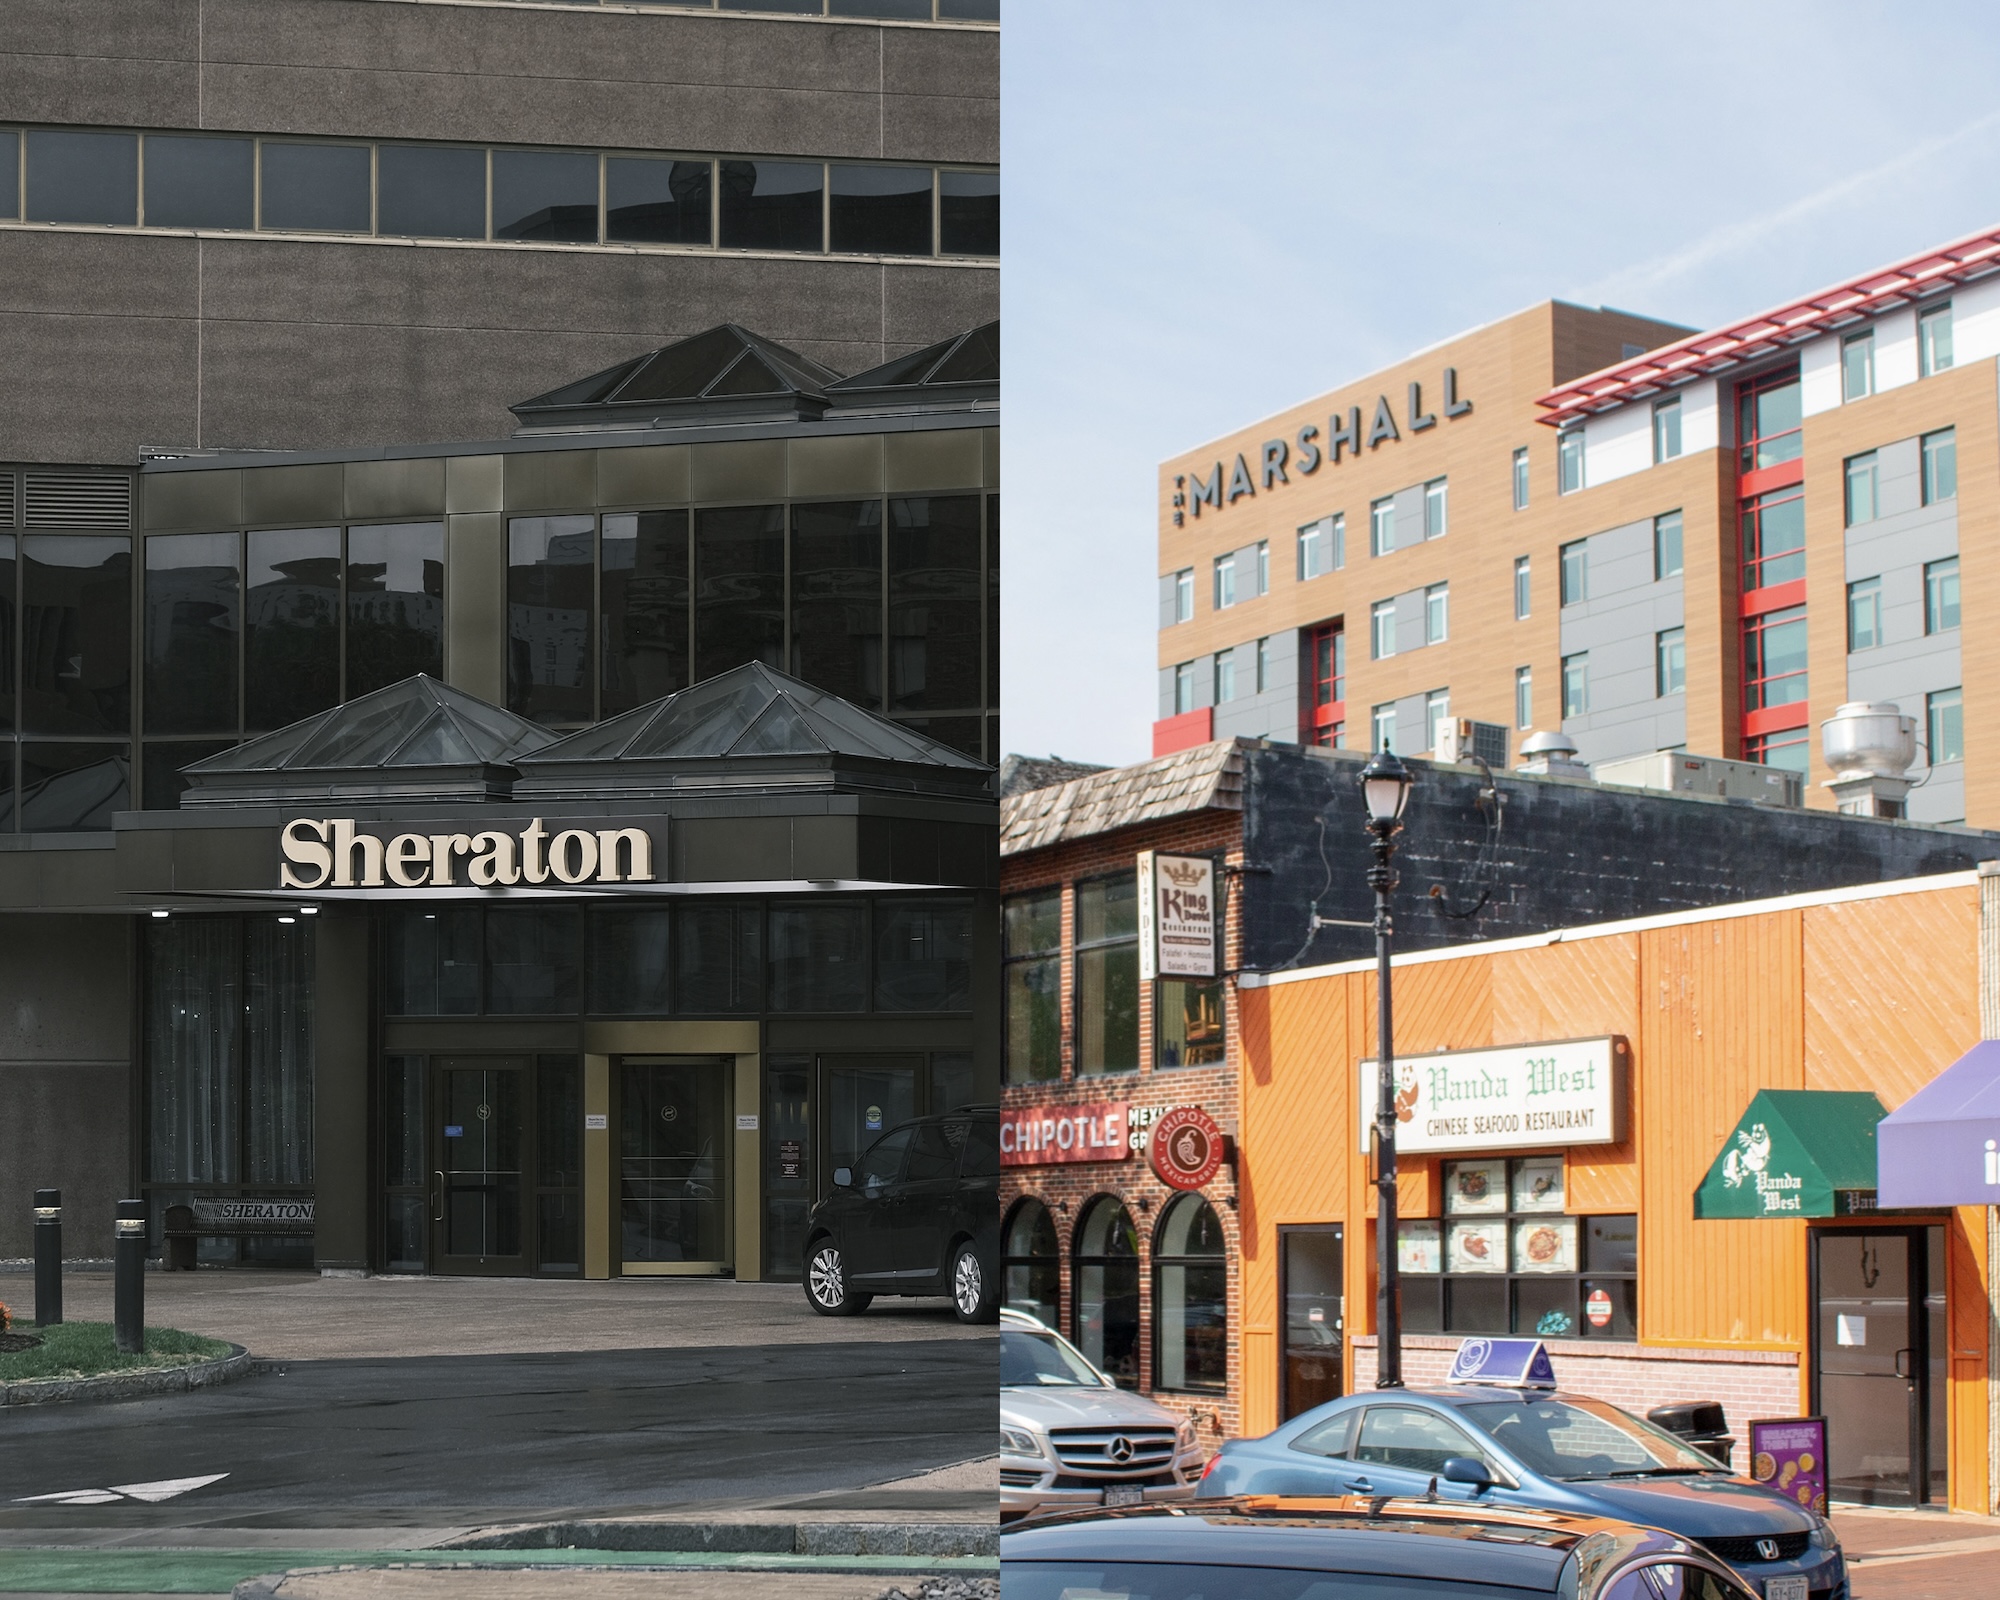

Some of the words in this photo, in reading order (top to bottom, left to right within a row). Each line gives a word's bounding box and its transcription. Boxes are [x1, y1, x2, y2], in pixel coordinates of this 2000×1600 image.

[1173, 474, 1185, 528] THE
[1190, 367, 1473, 519] MARSHALL
[281, 818, 657, 889] Sheraton
[1161, 888, 1208, 923] King
[1184, 910, 1210, 922] David
[1162, 922, 1212, 934] Restaurant
[1162, 949, 1183, 959] Falafel
[1167, 961, 1188, 971] Salads
[1426, 1066, 1509, 1111] Panda
[1525, 1057, 1596, 1106] West
[1000, 1113, 1120, 1153] CHIPOTLE
[1157, 1111, 1220, 1142] CHIPOTLE
[1427, 1117, 1469, 1136] CHINESE
[1474, 1114, 1519, 1134] SEAFOOD
[1525, 1108, 1595, 1131] RESTAURANT
[1160, 1156, 1198, 1184] MEXICAN
[1198, 1156, 1220, 1181] GRILL
[1754, 1171, 1802, 1194] Panda
[222, 1204, 312, 1218] SHERATON
[1762, 1191, 1801, 1215] West
[1846, 1191, 1878, 1214] Pan
